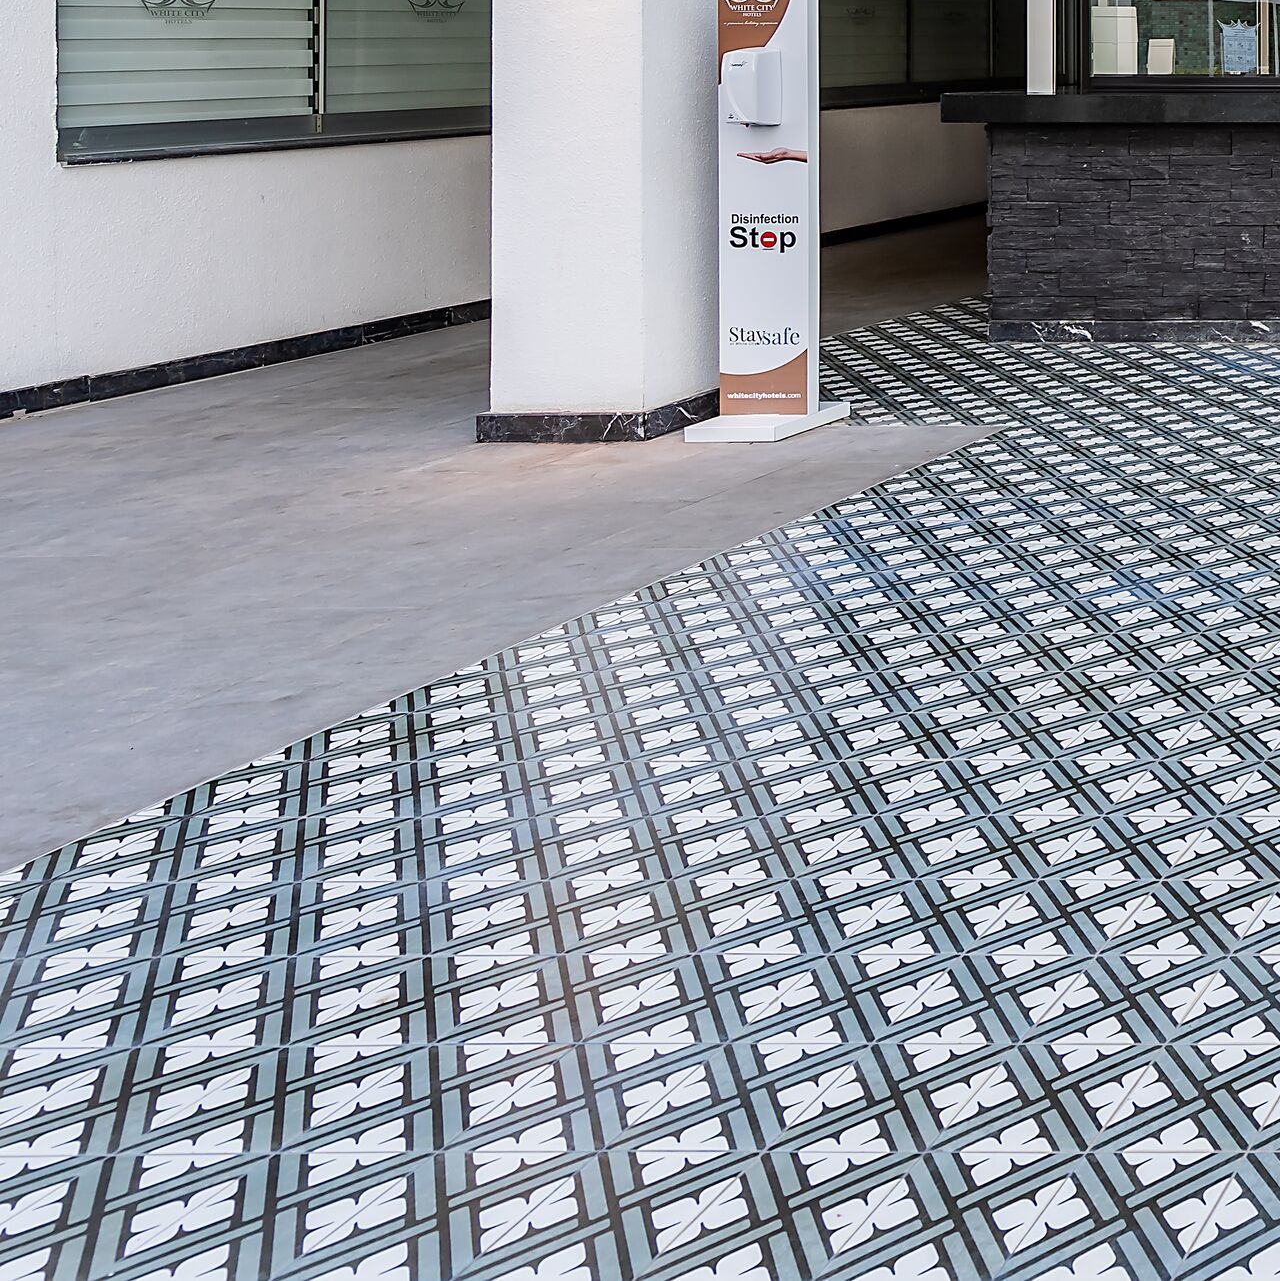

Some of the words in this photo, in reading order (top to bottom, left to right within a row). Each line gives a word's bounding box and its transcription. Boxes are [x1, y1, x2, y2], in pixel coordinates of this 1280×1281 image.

[150, 9, 182, 17] WHITE
[184, 9, 206, 17] CITY
[731, 213, 799, 224] Disinfection
[727, 392, 801, 400] whitecityhotels.com
